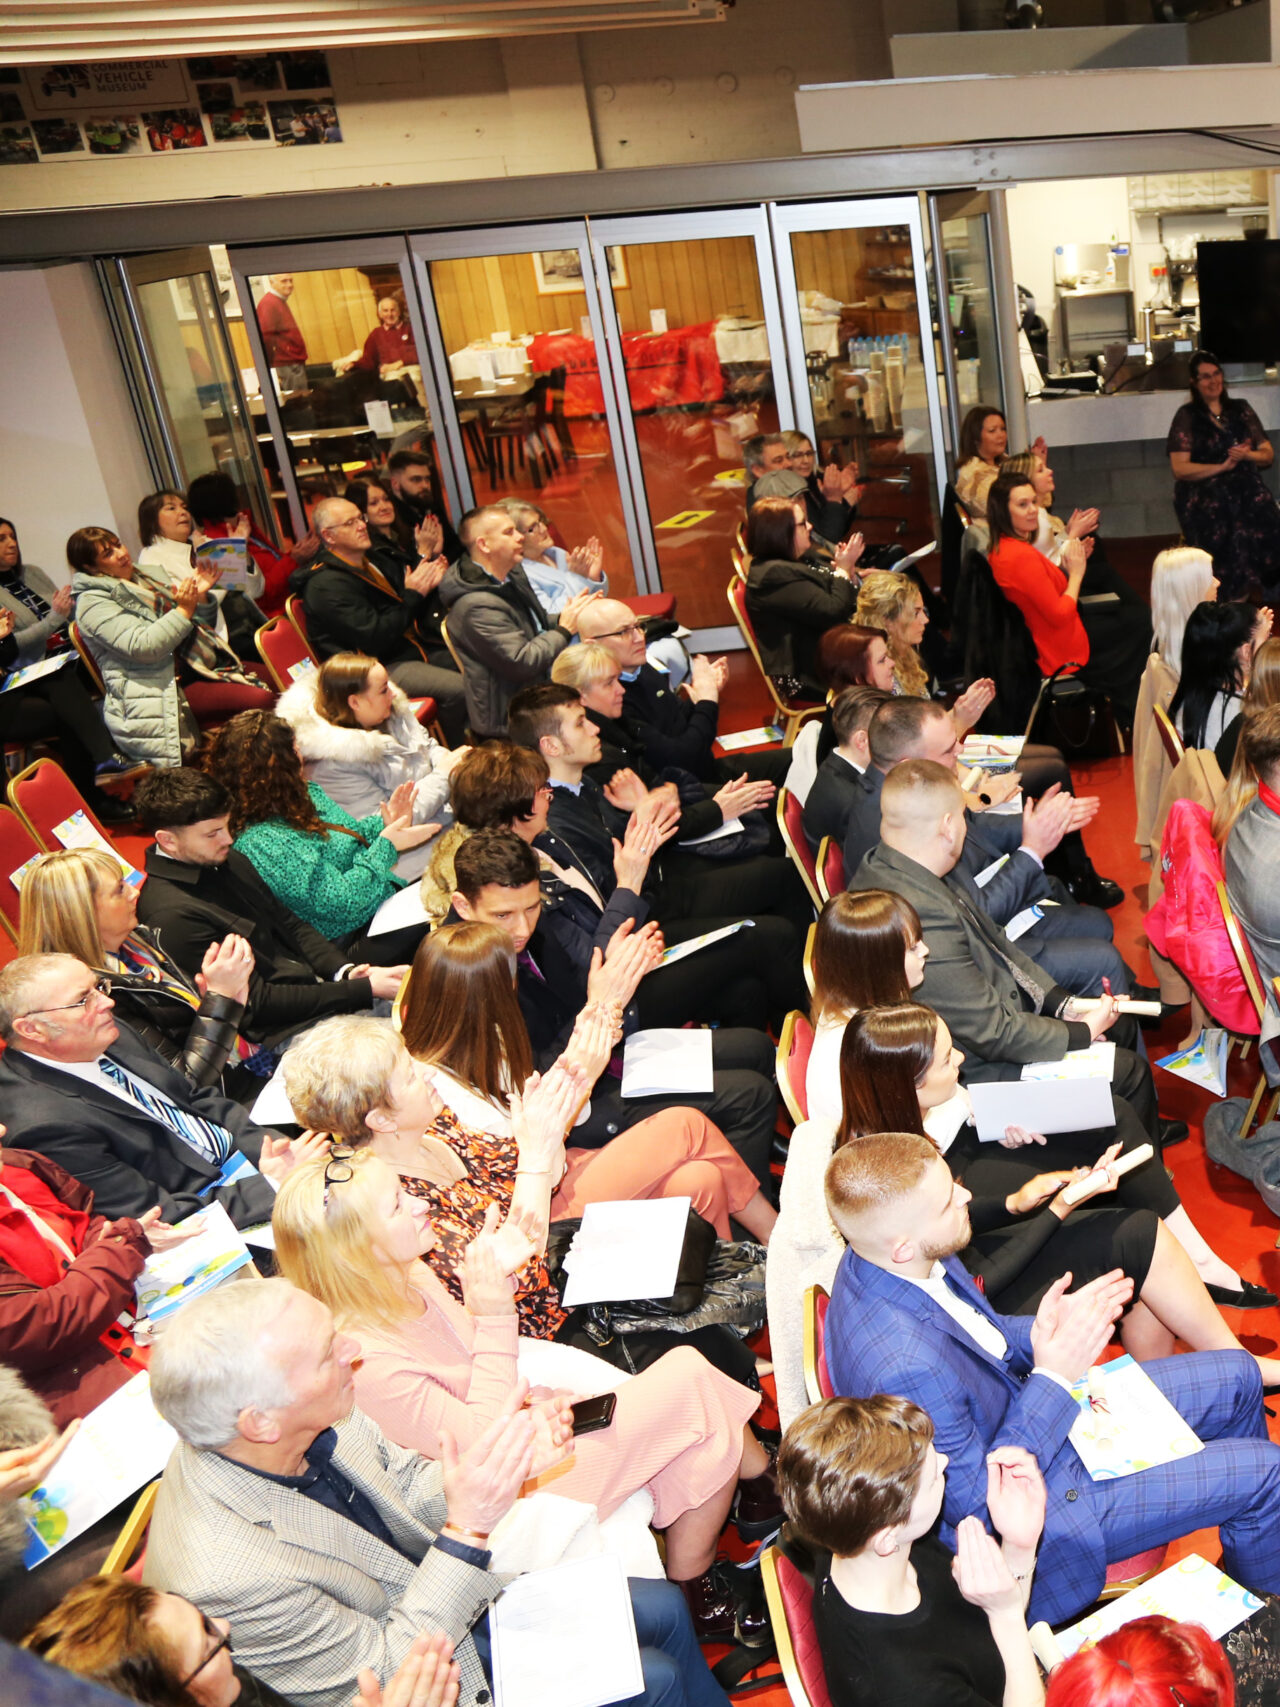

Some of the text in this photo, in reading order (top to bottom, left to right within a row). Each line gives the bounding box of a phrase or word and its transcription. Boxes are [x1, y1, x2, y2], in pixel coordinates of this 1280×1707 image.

[91, 60, 168, 72] COMMERCIAL
[95, 70, 153, 83] VEHICLE
[97, 82, 147, 92] MUSEUM
